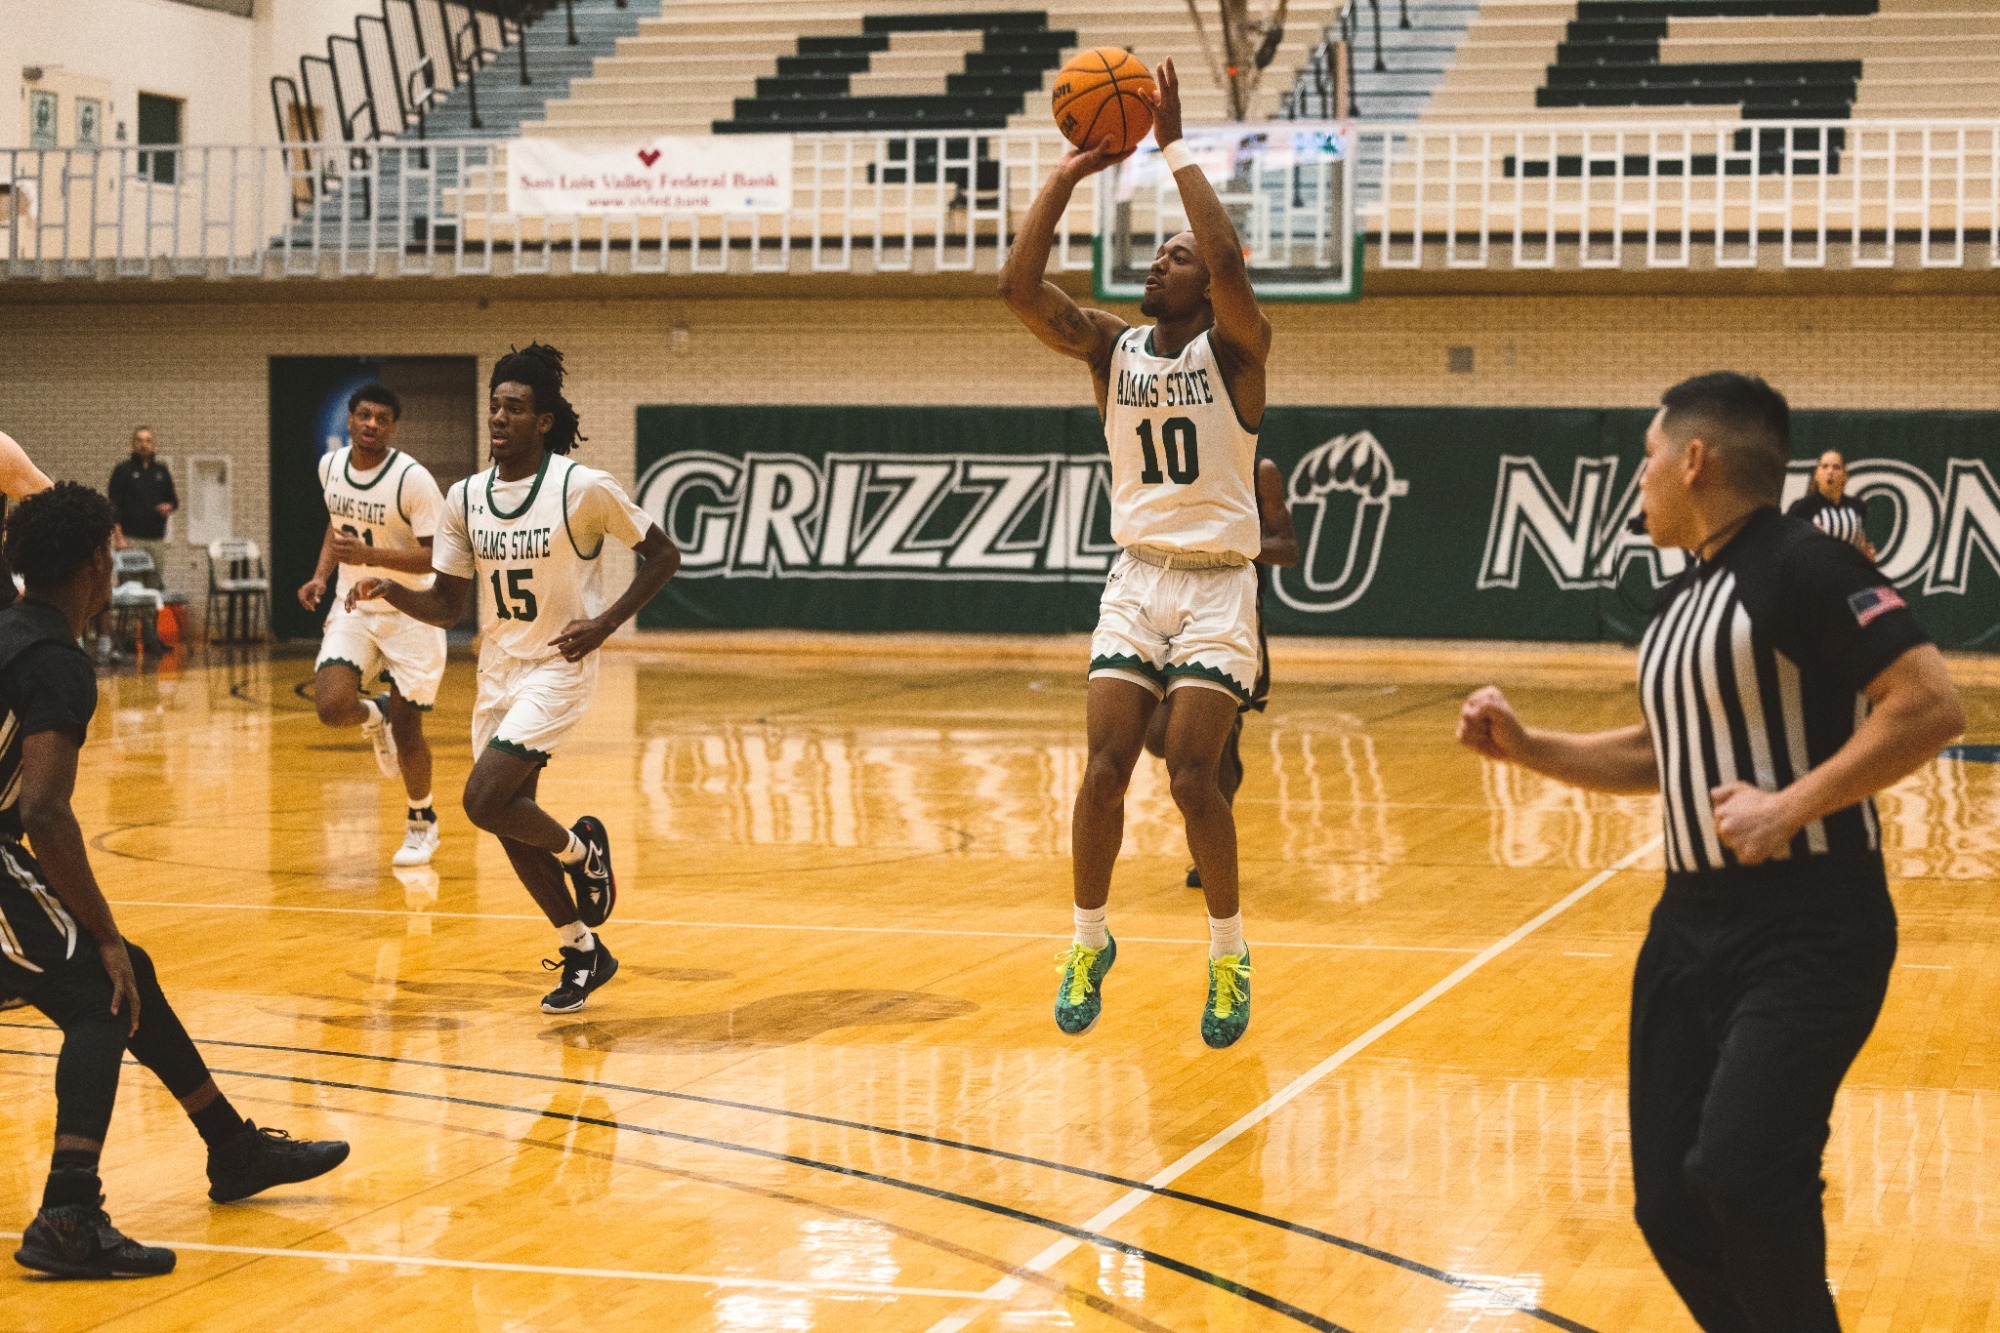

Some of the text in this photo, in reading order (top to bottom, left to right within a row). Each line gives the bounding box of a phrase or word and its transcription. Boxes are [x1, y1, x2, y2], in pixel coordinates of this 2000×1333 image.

[520, 171, 778, 191] San Luis Valley Federal Bank
[1116, 368, 1214, 407] ADAMS STATE
[1136, 416, 1200, 485] 10
[357, 500, 387, 526] STATE
[635, 450, 1113, 583] GRIZZL
[511, 527, 551, 560] STATE
[490, 568, 538, 622] 15
